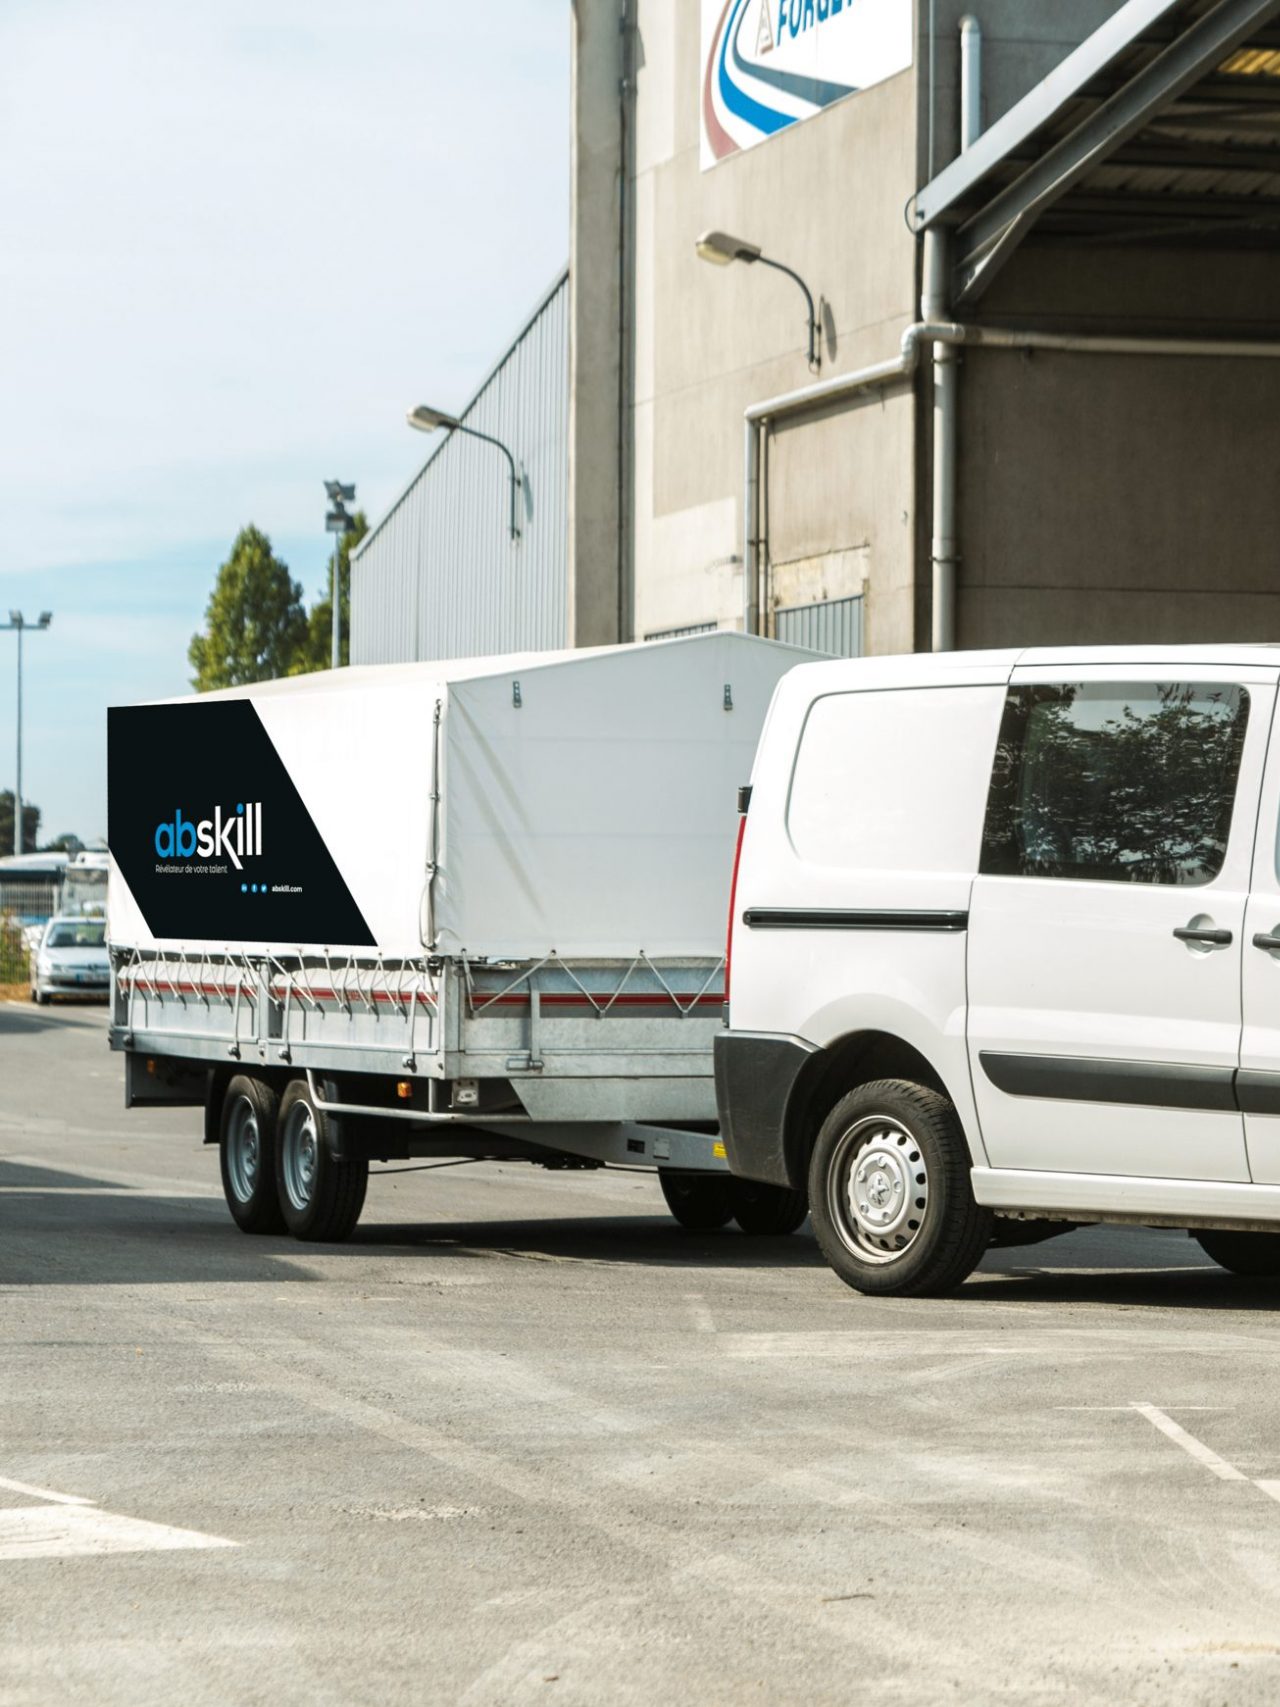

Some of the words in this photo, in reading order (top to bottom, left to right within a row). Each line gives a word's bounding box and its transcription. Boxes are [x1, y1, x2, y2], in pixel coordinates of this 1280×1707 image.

[777, 0, 852, 47] FORG
[155, 802, 262, 870] abskill
[184, 864, 193, 873] de
[193, 865, 209, 873] votre
[209, 864, 228, 874] talent
[271, 884, 303, 893] abskill.com
